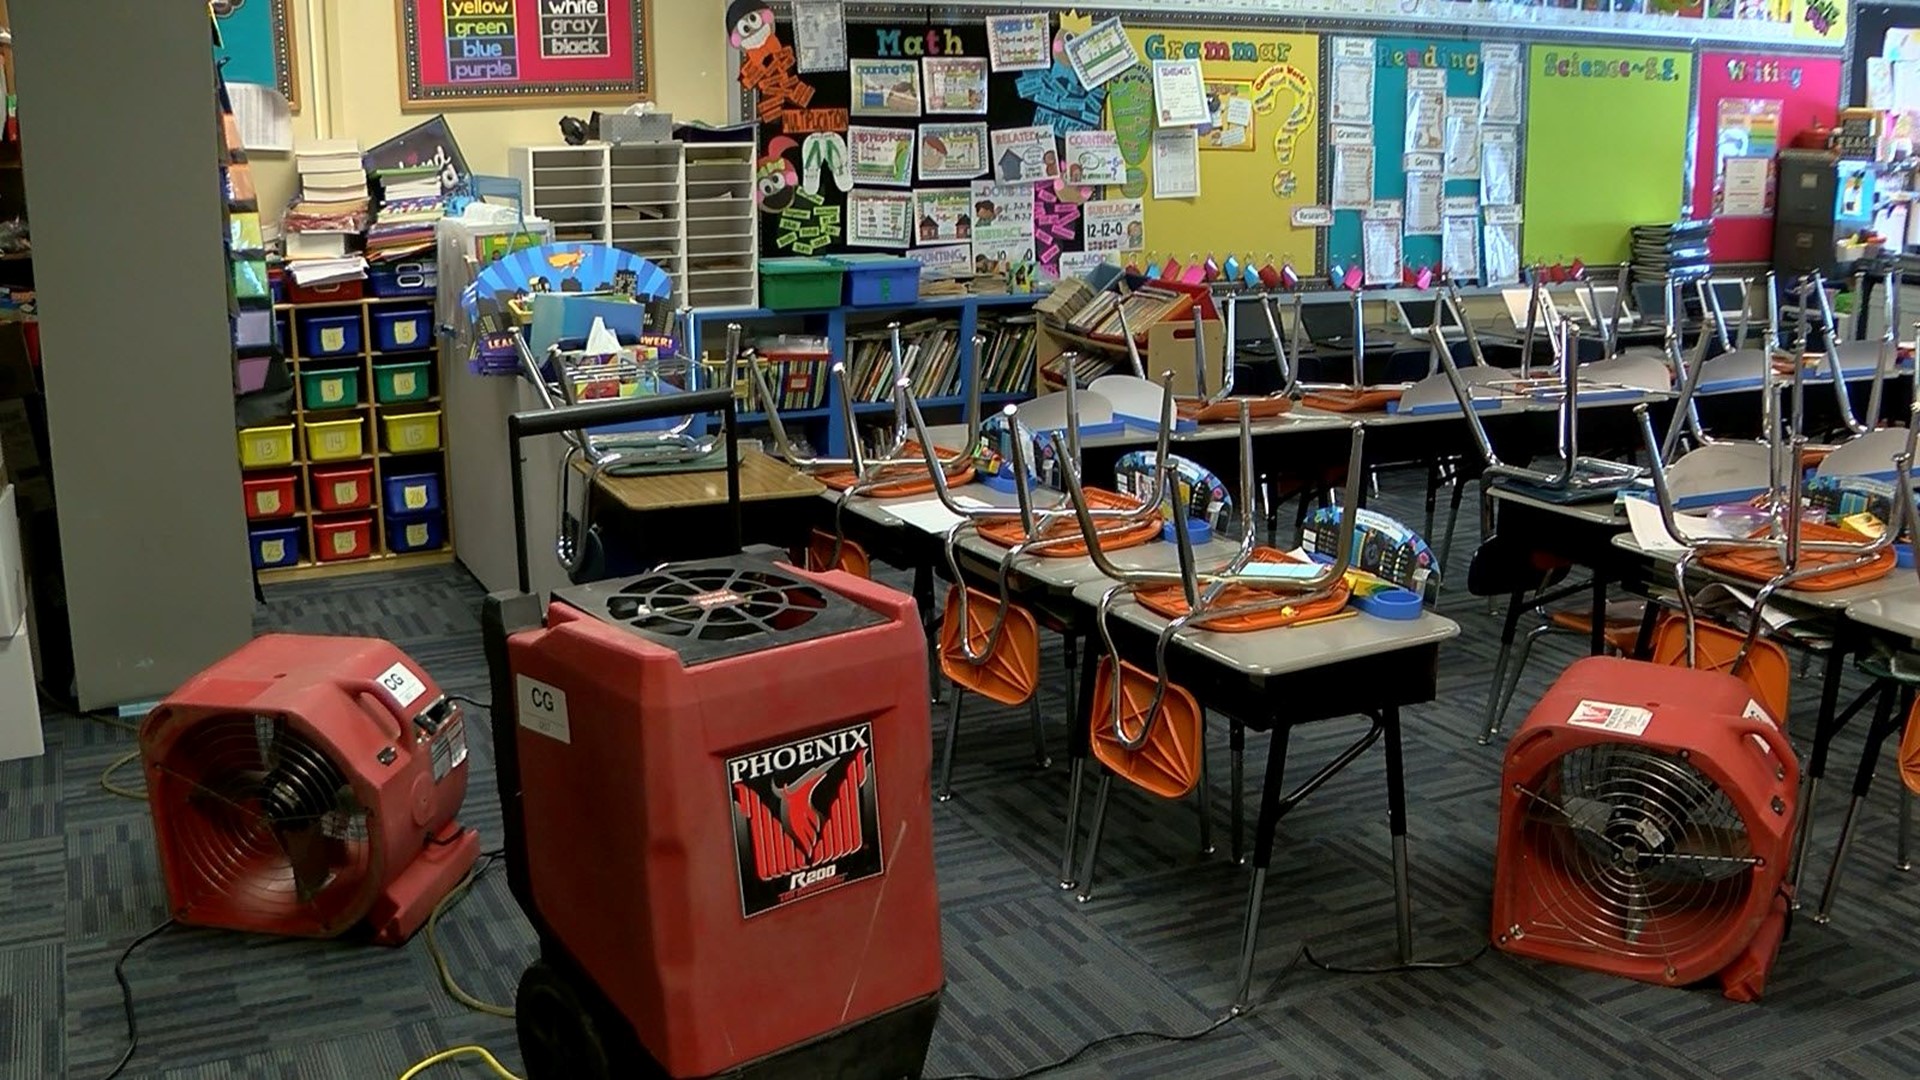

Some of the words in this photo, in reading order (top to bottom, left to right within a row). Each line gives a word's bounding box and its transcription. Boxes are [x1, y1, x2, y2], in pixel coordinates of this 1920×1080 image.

[452, 0, 507, 15] yellow
[550, 0, 598, 14] white
[455, 19, 508, 37] green
[551, 17, 597, 37] gray
[463, 41, 502, 57] blue
[552, 38, 600, 54] black
[876, 28, 964, 56] Math
[1145, 34, 1291, 62] Grammar
[1378, 45, 1479, 75] Reading
[455, 61, 512, 79] purple
[996, 131, 1035, 145] RELATED
[1337, 129, 1367, 139] Grammar
[1415, 157, 1434, 167] Genre
[1299, 209, 1328, 219] Research
[326, 332, 337, 346] 4
[402, 325, 411, 338] 5
[641, 335, 673, 348] WER!
[327, 384, 335, 396] 9
[330, 433, 341, 447] 14
[410, 428, 422, 442] 15
[260, 441, 272, 456] 13
[384, 673, 404, 691] CG
[532, 687, 554, 712] CG
[730, 726, 869, 784] PHOENIX
[790, 864, 837, 890] R200
